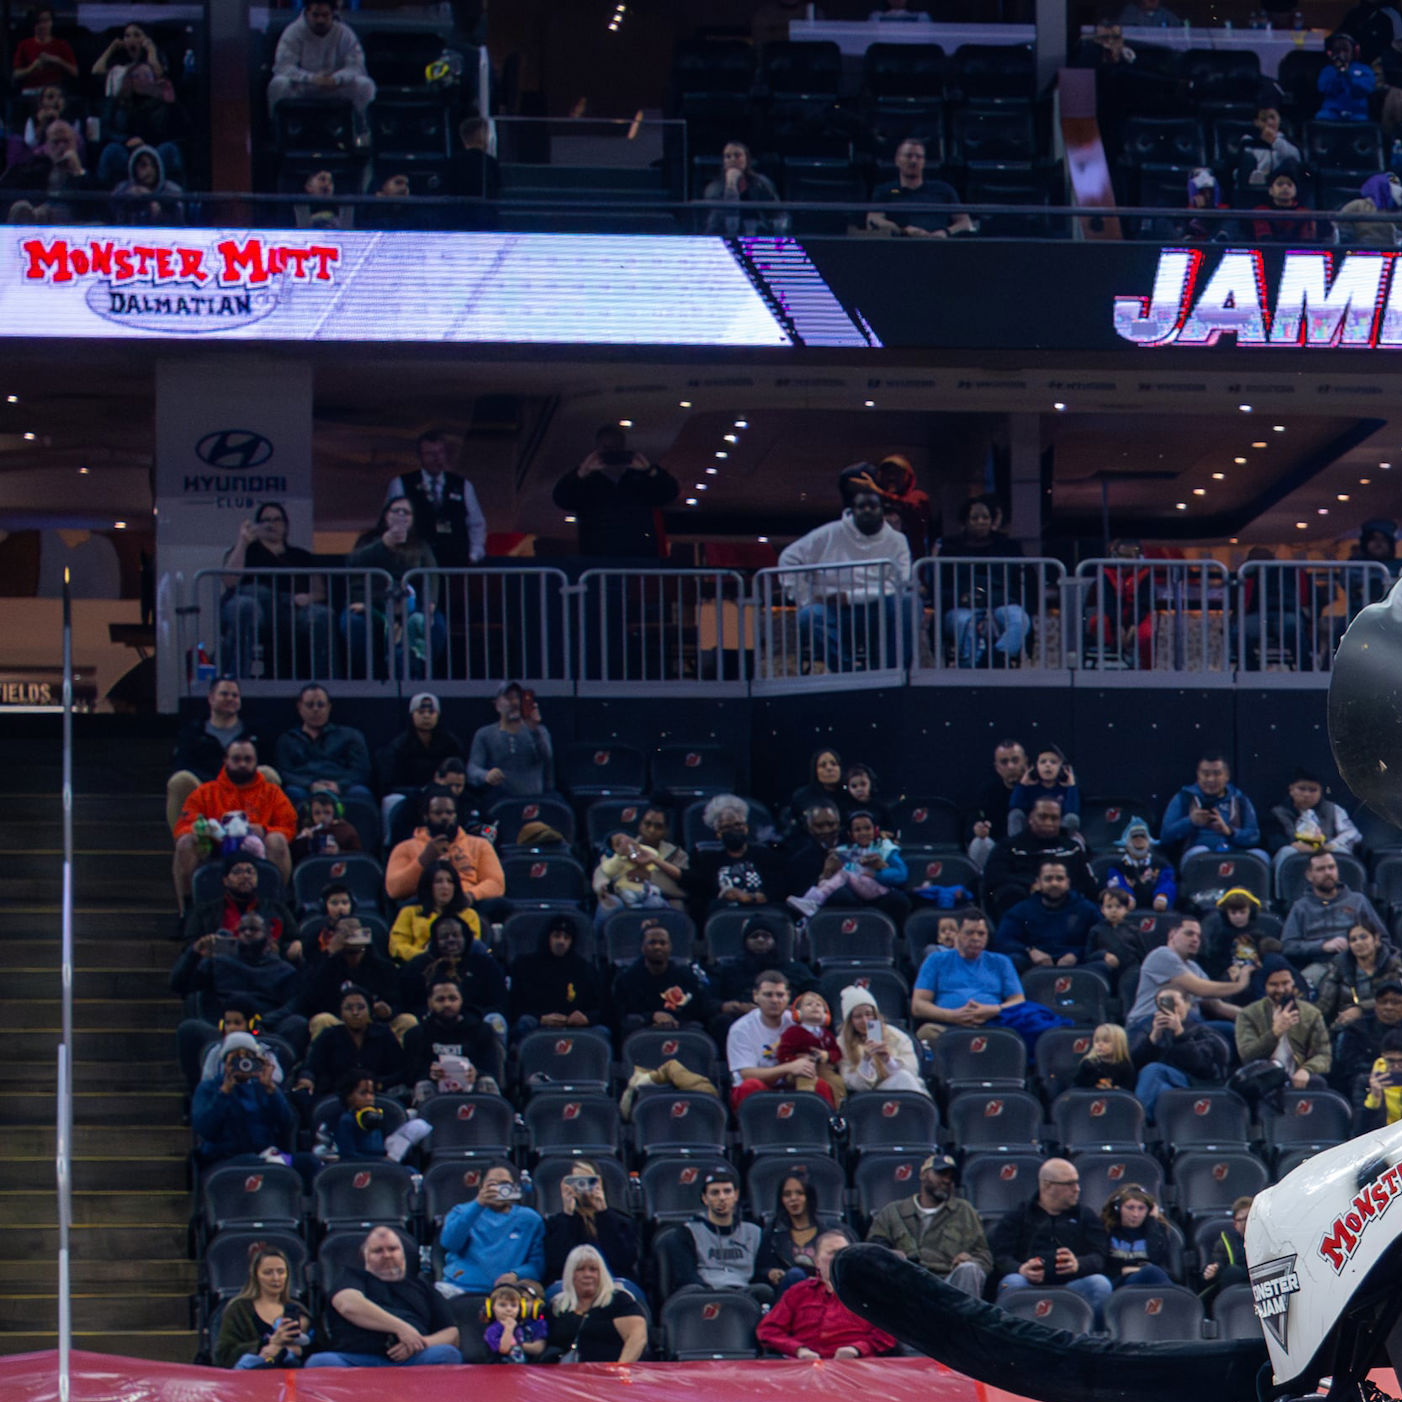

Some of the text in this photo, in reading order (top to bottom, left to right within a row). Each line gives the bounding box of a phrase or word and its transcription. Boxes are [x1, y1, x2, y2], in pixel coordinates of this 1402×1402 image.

[23, 239, 339, 283] MONSTER MUTT
[109, 290, 251, 315] DALMATIAN
[184, 476, 287, 492] HYUNDAI
[1259, 1297, 1287, 1319] JAM
